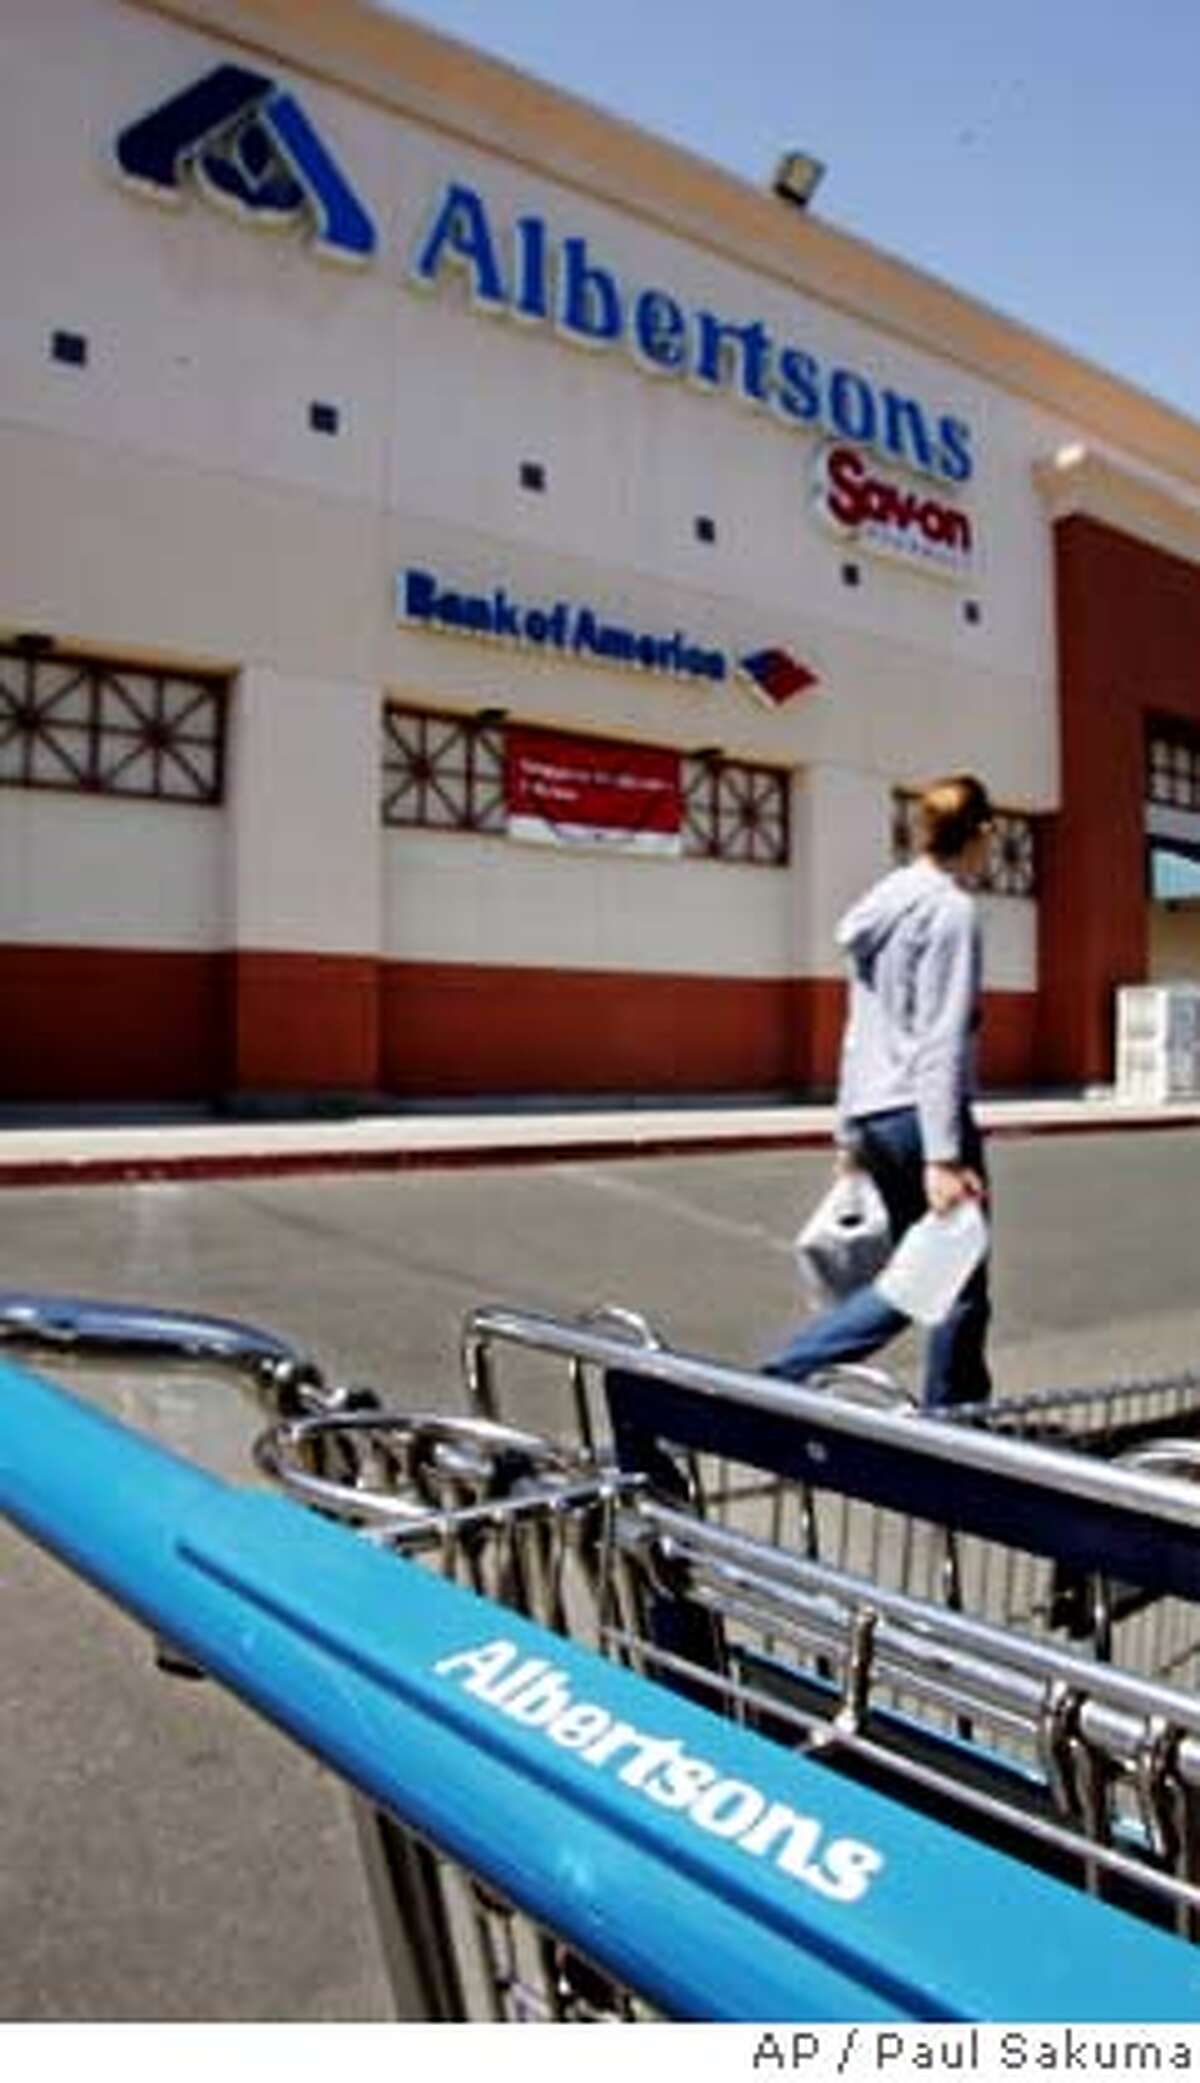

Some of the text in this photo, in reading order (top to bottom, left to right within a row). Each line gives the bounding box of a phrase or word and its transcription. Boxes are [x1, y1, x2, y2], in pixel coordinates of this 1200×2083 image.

[417, 181, 974, 483] Albertsons
[404, 567, 727, 681] Bank of America
[432, 1638, 886, 1902] Albertsons
